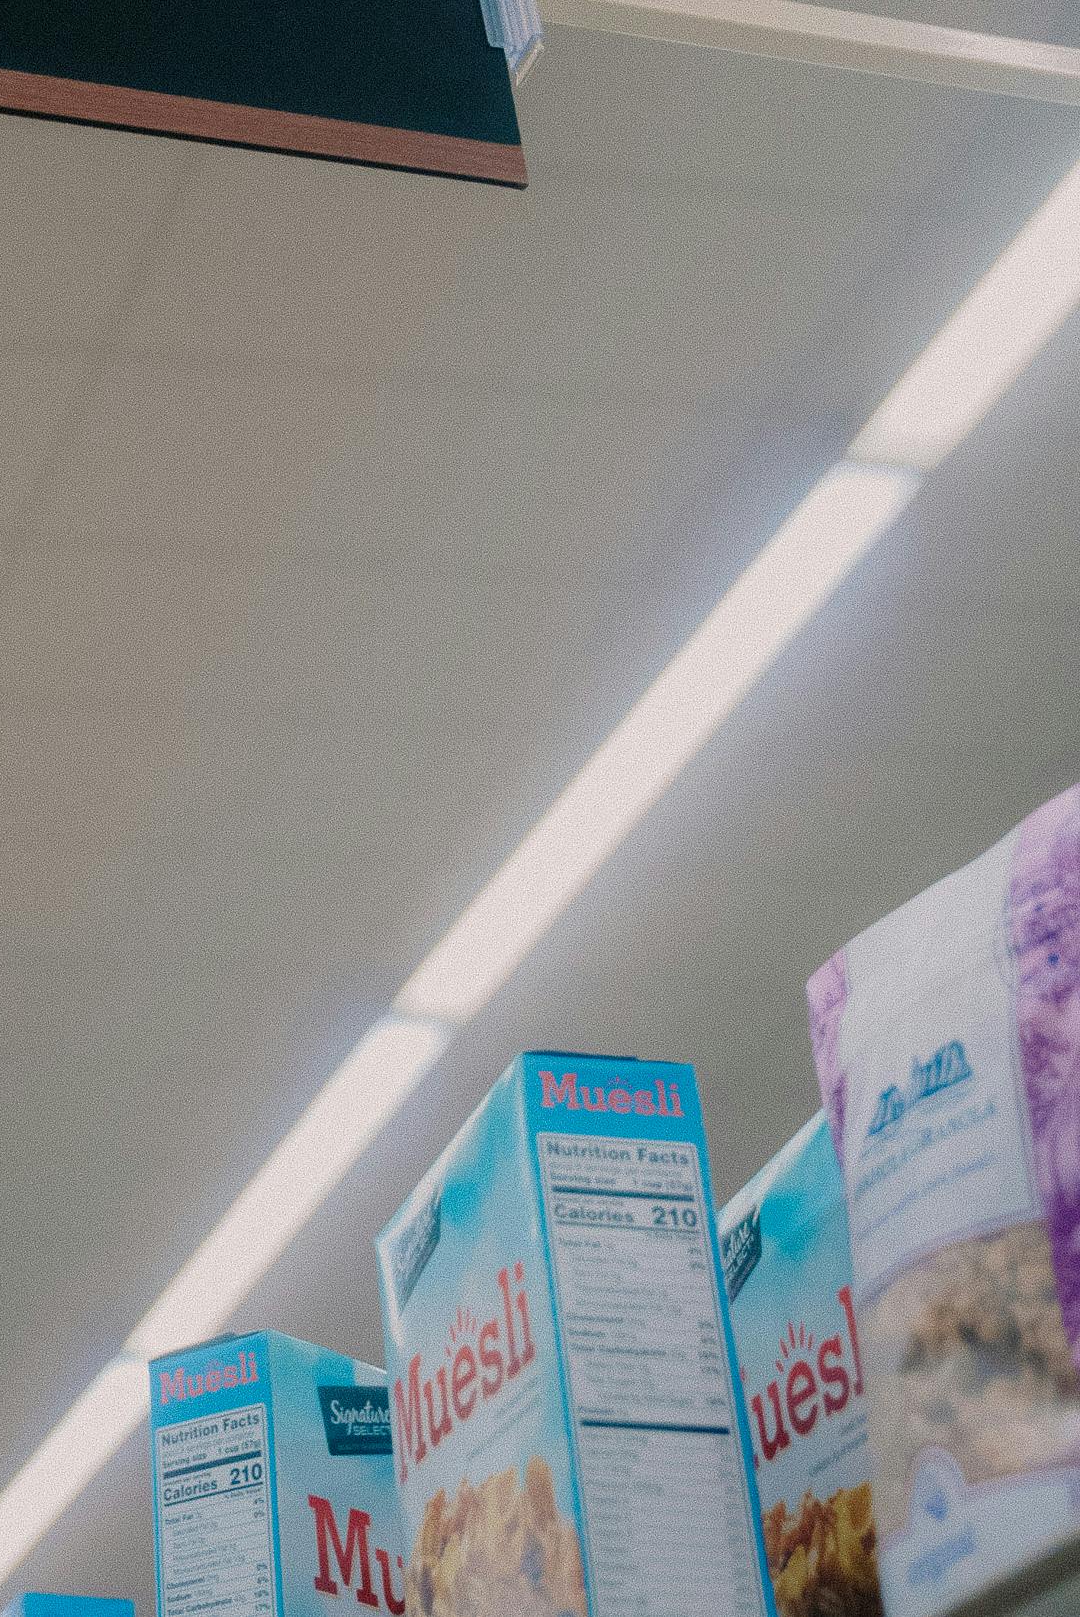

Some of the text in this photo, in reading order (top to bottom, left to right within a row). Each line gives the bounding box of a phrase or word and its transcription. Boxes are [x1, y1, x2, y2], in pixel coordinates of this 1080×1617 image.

[538, 1070, 685, 1117] Muesli
[546, 1140, 689, 1166] Nutrition Facts
[553, 1203, 698, 1228] Calories 210
[158, 1351, 259, 1404] Muesli
[394, 1260, 536, 1485] Muesli
[161, 1423, 219, 1446] Nutrition
[222, 1413, 261, 1434] Facts
[330, 1399, 391, 1436] Signature
[163, 1479, 218, 1501] Calories
[229, 1462, 263, 1485] 210
